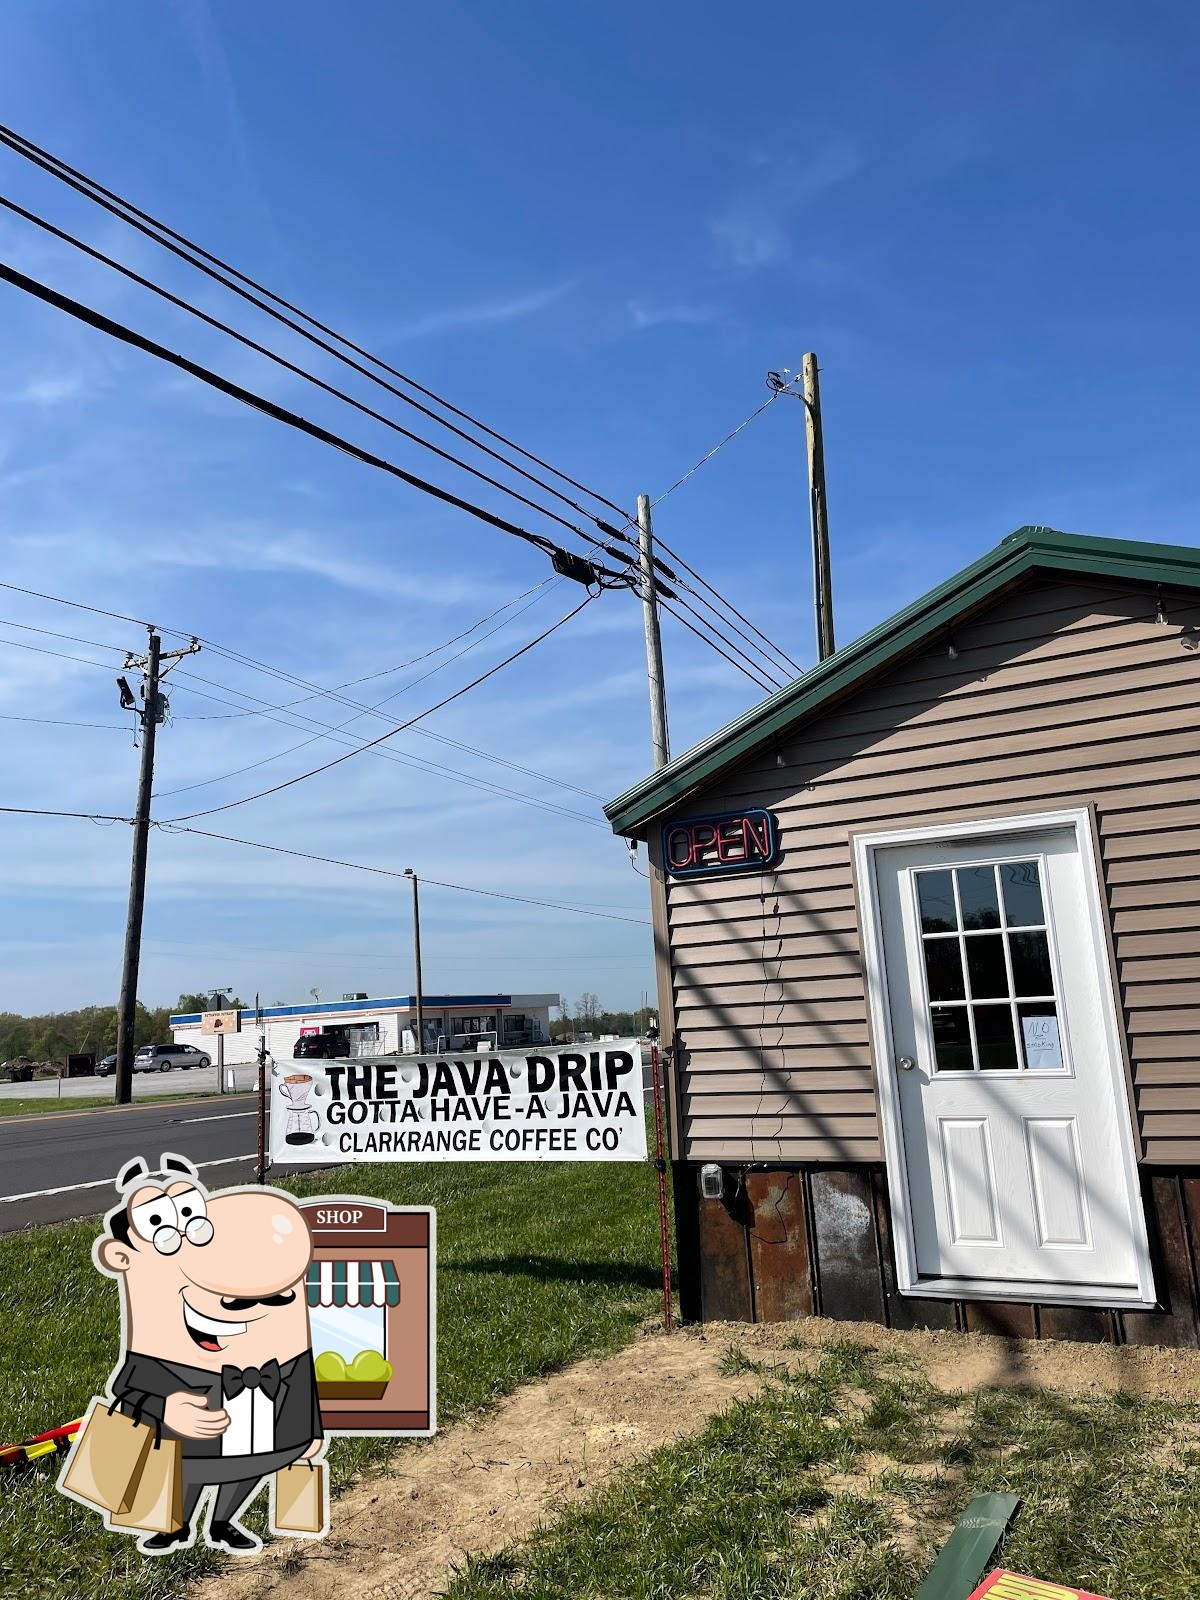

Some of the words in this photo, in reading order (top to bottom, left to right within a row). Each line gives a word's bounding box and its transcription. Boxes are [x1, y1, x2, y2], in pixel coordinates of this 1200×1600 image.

[667, 818, 770, 868] OPEN
[1028, 1021, 1050, 1035] NO
[325, 1064, 399, 1101] THE
[412, 1058, 512, 1099] JAVA
[525, 1050, 634, 1094] DRIP
[326, 1099, 420, 1125] GOTTA
[557, 1091, 638, 1119] JAVA
[339, 1129, 482, 1153] CLARKRANGE
[489, 1128, 578, 1152] COFFEE
